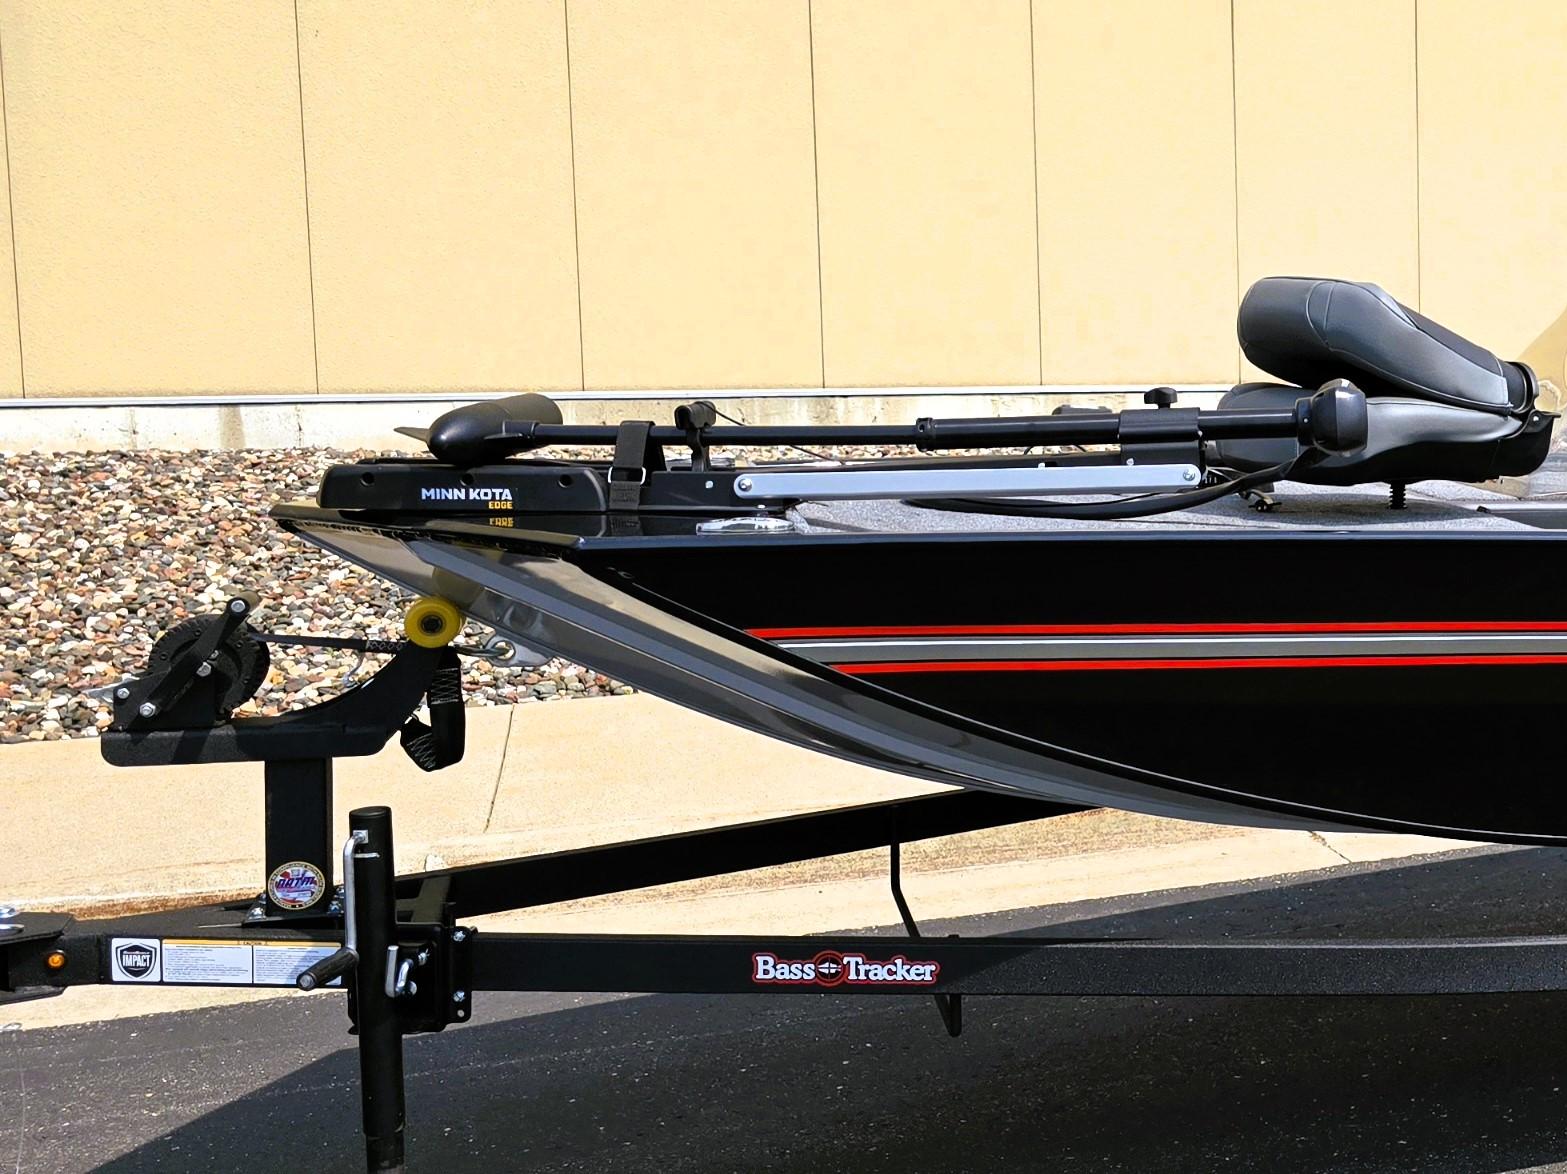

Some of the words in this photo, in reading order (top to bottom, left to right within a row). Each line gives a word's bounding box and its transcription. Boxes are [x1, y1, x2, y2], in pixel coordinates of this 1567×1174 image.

[421, 487, 466, 500] MINN
[469, 487, 513, 500] KOTA
[488, 501, 513, 509] EDGE
[122, 954, 151, 967] IMPACT
[755, 955, 816, 980] Bass
[843, 956, 936, 981] Tracker
